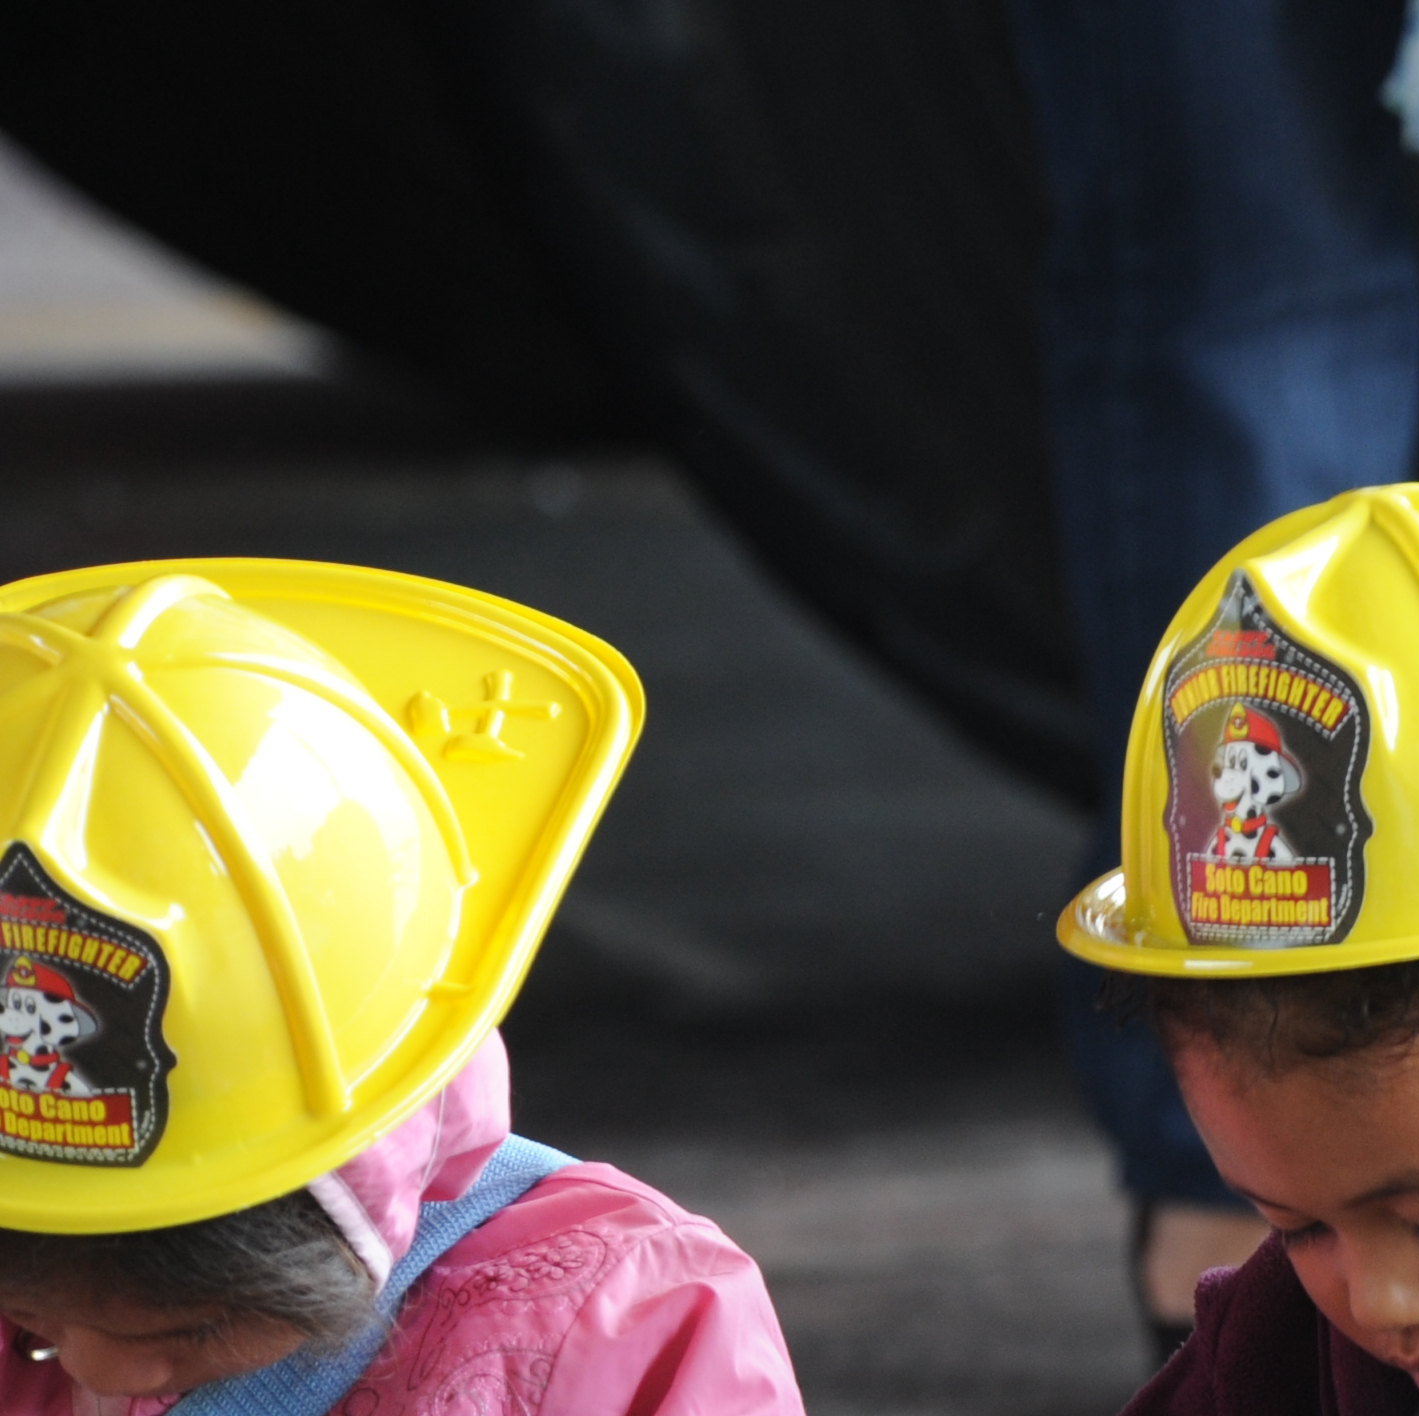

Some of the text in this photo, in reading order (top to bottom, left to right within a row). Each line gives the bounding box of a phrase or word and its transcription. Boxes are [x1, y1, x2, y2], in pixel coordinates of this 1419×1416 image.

[1170, 664, 1345, 729] JUNIOR FIREFIGHTER
[1205, 863, 1308, 897] Soto Cano
[1191, 892, 1329, 925] Fire Department
[1, 920, 142, 981] FIREFIGHTER
[39, 1093, 106, 1122] Cano
[4, 1110, 131, 1147] Department
